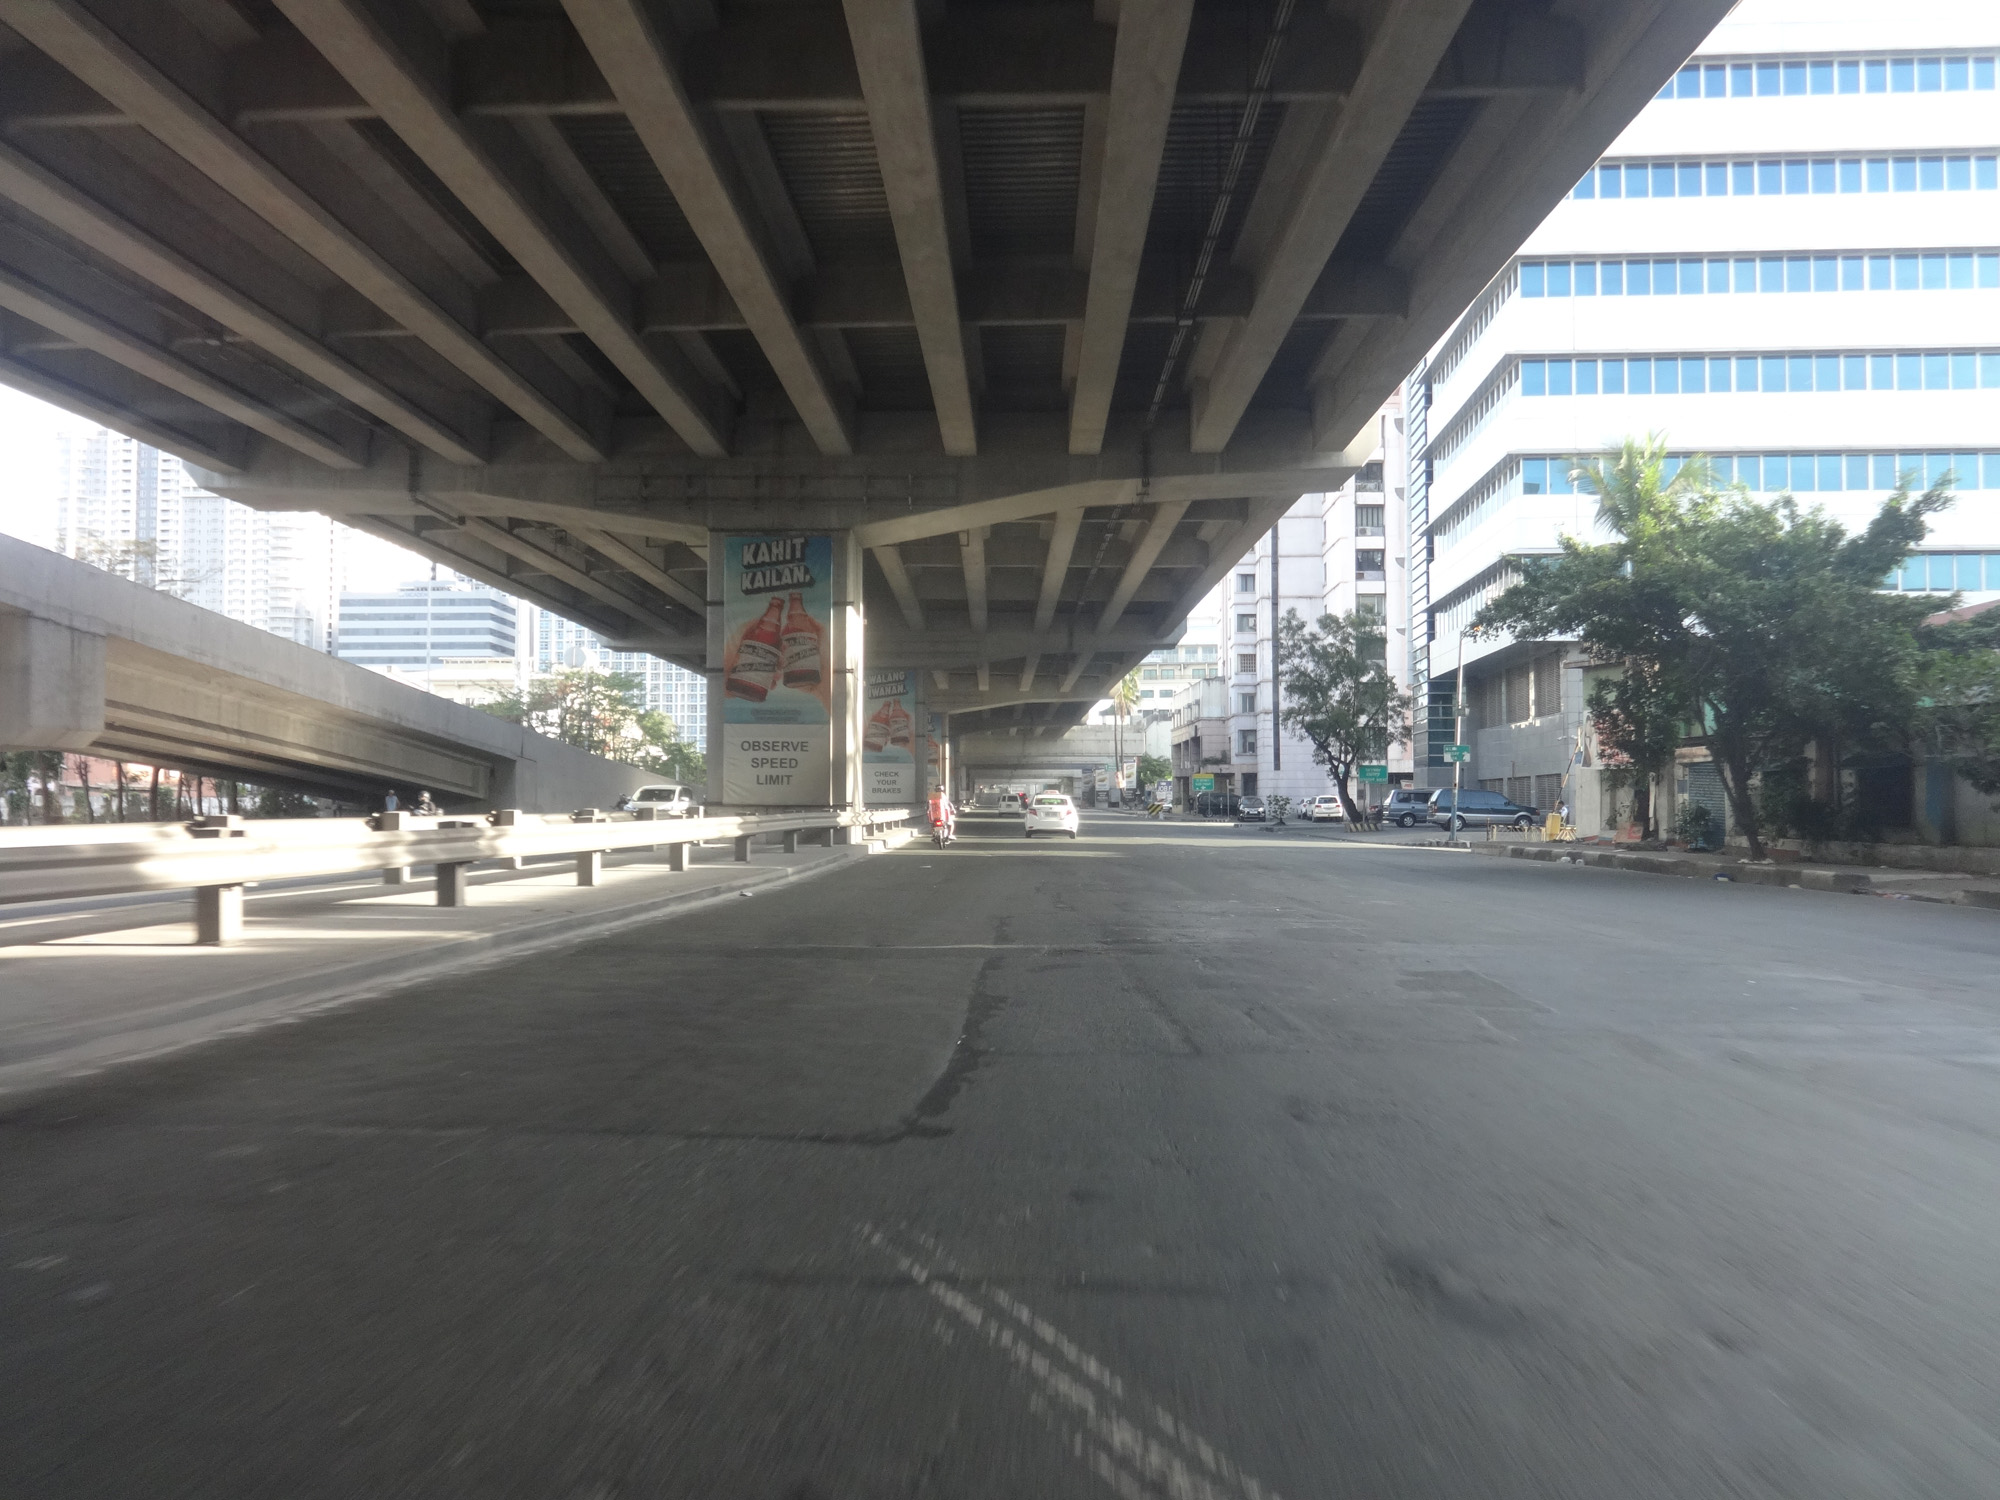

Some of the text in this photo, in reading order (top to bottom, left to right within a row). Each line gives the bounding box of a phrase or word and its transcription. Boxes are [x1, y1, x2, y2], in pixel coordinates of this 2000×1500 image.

[743, 536, 806, 567] KAHIT
[868, 671, 905, 685] WALANG
[741, 740, 809, 752] OBSERVE
[751, 757, 798, 769] SPEED
[756, 774, 793, 785] LIMIT
